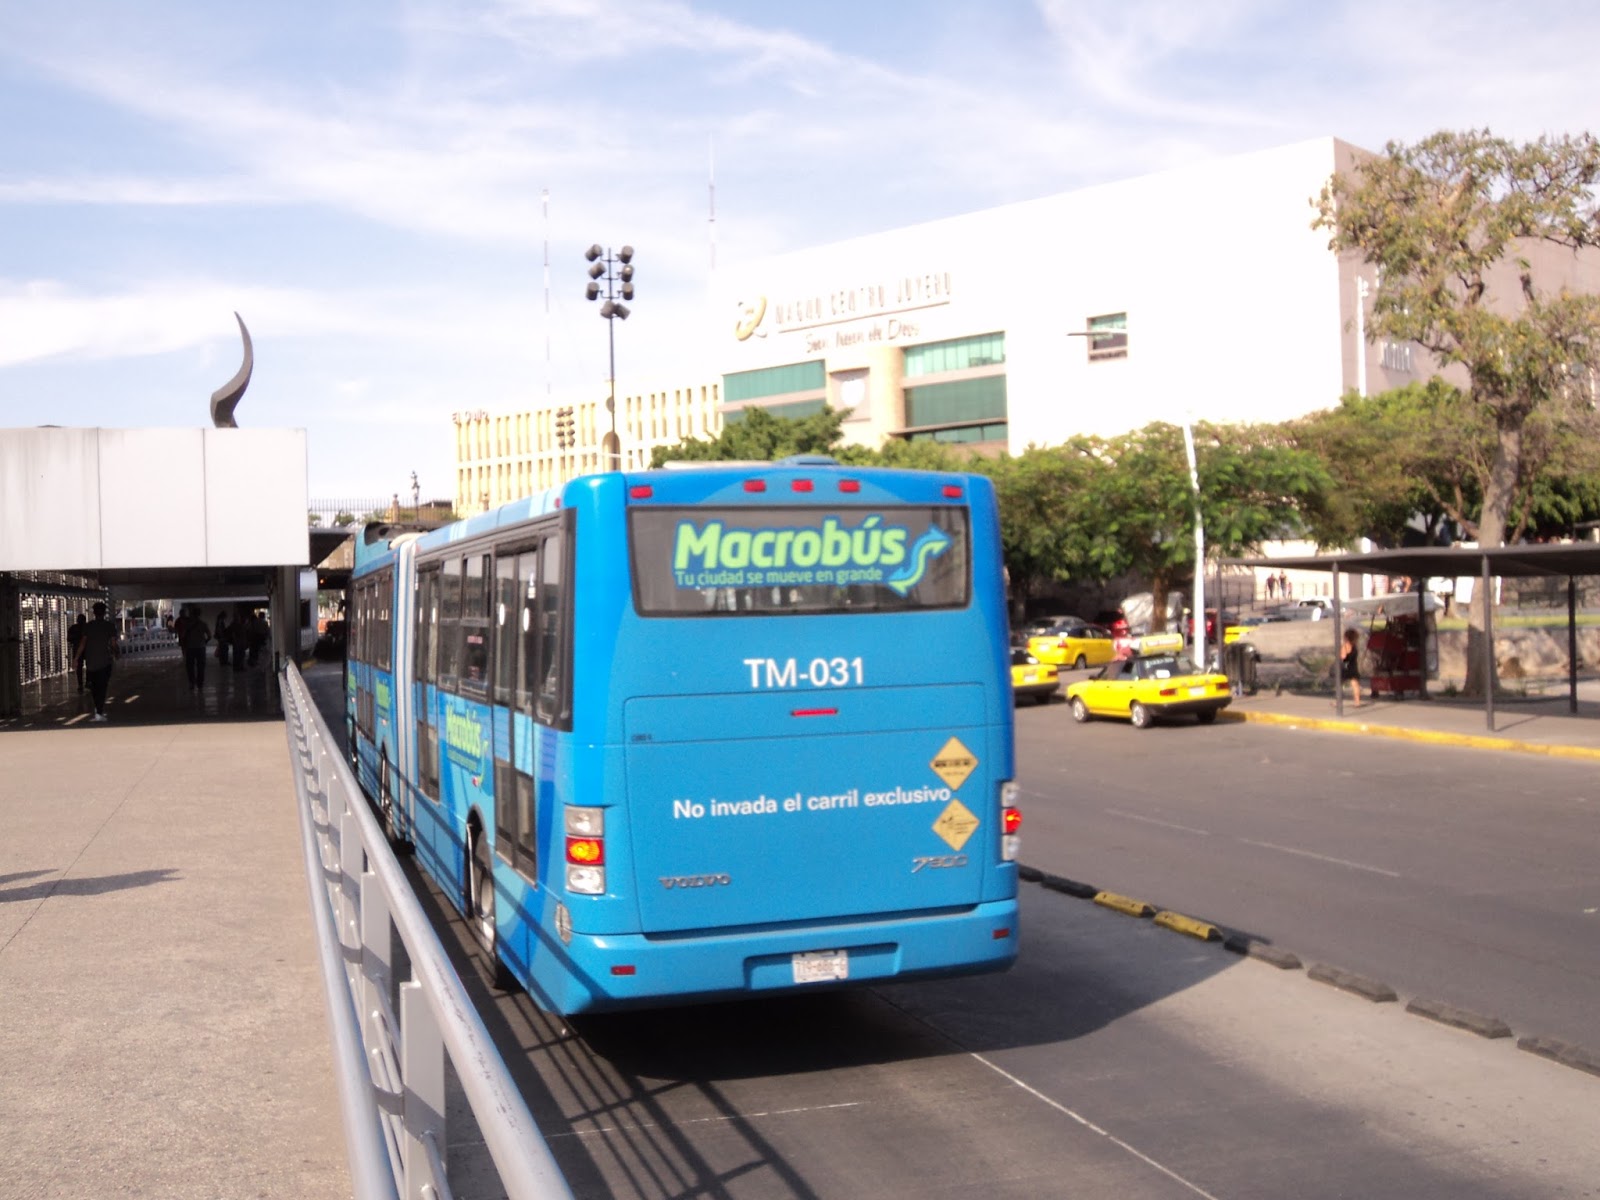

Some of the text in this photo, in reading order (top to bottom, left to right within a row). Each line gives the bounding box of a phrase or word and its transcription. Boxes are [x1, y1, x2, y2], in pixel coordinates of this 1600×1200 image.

[674, 515, 907, 570] Macrobús
[675, 568, 883, 586] Tu ciudad se mueve en grande
[743, 657, 864, 688] TM-031
[673, 785, 951, 819] No invada el carril exclusivo
[659, 873, 732, 890] VOLVO
